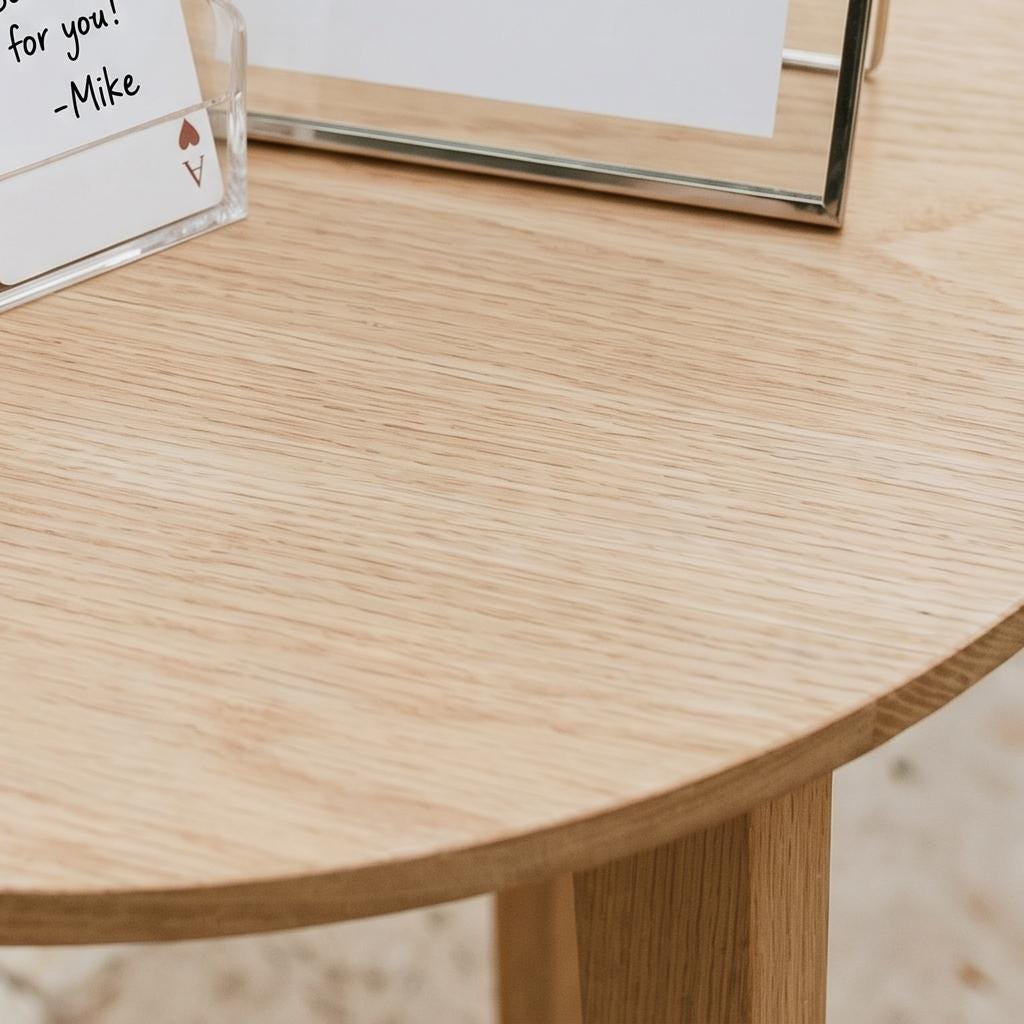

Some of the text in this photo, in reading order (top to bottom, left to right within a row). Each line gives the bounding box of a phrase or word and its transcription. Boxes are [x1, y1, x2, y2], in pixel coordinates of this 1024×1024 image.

[7, 23, 49, 64] for
[53, 65, 141, 119] -Mike
[182, 154, 204, 188] A
